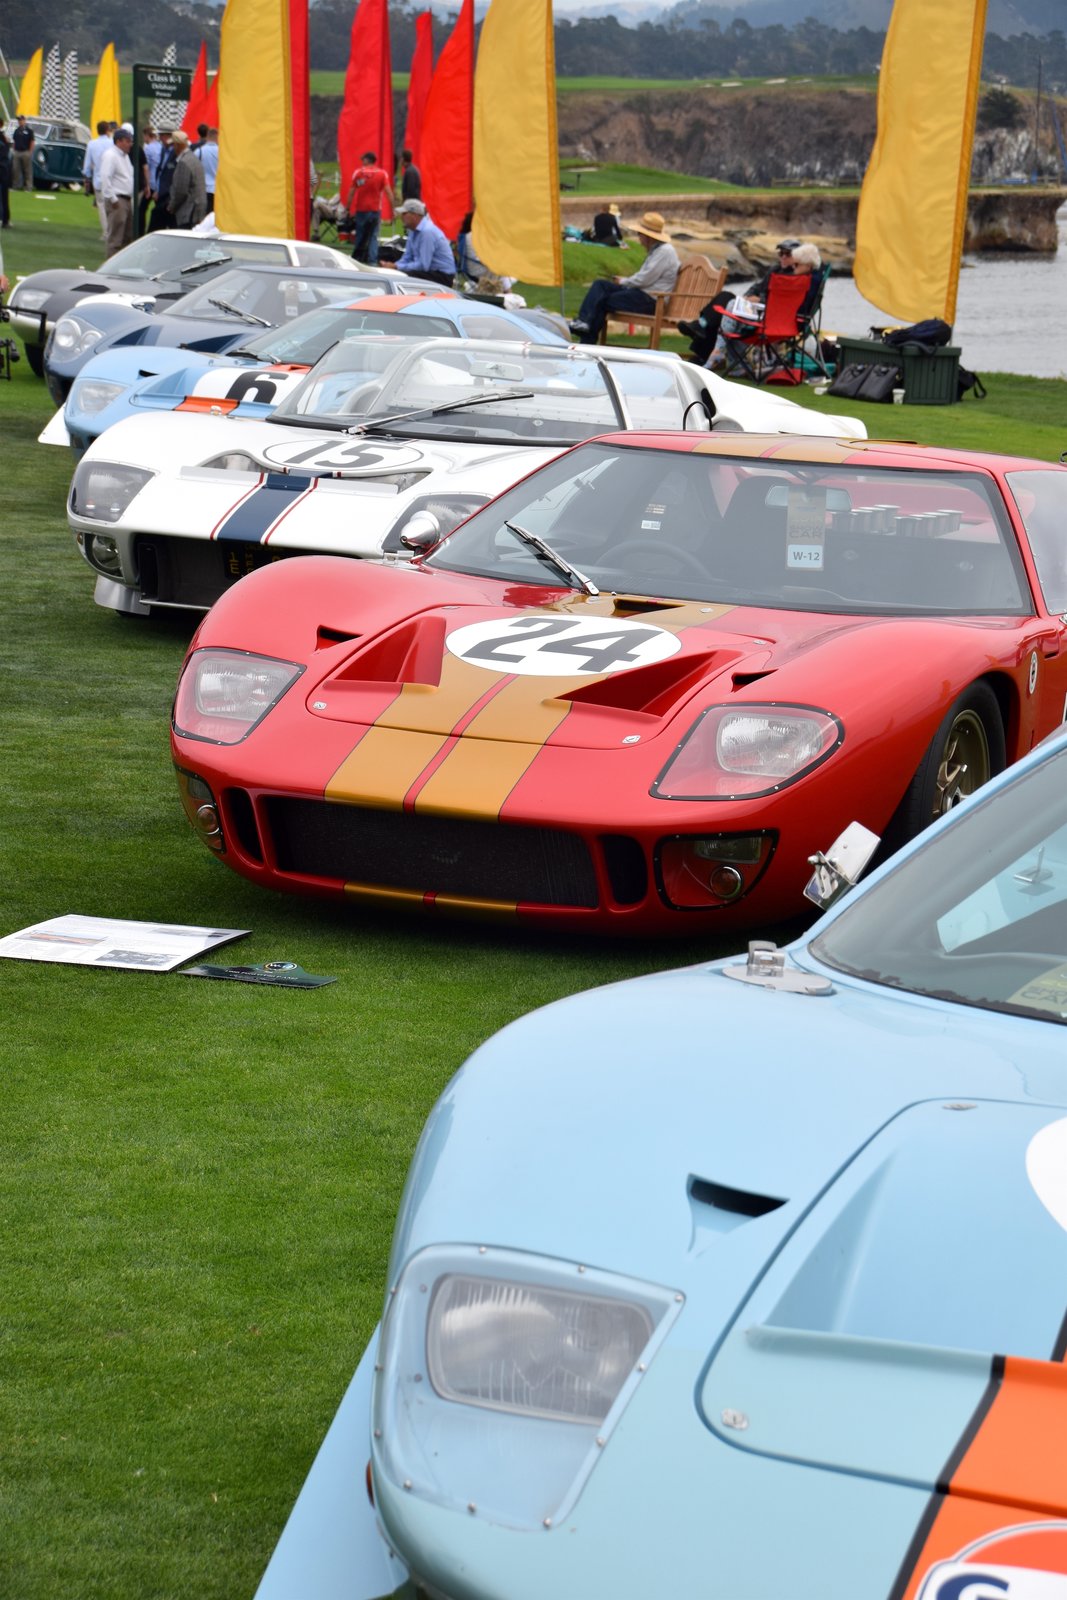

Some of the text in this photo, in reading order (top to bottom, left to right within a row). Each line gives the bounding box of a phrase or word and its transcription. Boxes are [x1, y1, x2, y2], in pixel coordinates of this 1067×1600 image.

[225, 371, 289, 403] 6
[284, 440, 404, 468] 15
[793, 551, 820, 561] W-12
[460, 617, 664, 672] 24
